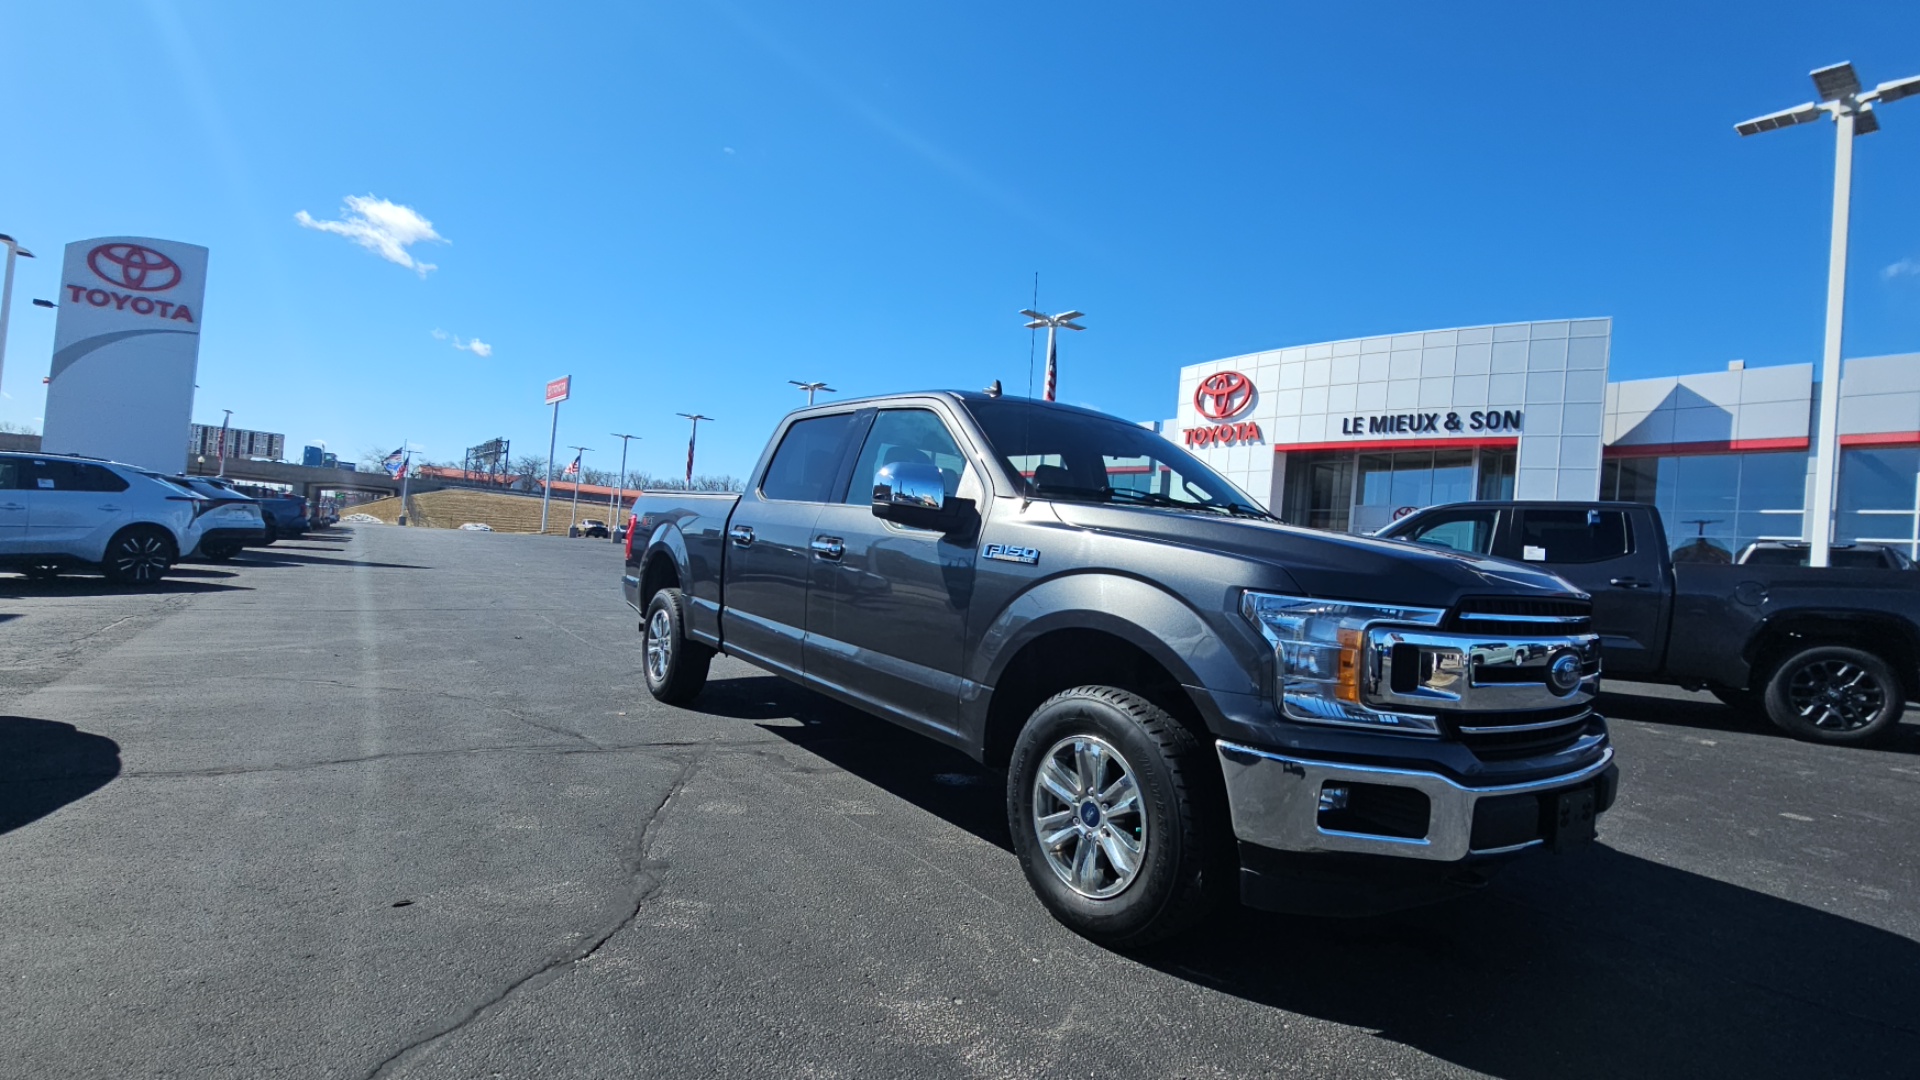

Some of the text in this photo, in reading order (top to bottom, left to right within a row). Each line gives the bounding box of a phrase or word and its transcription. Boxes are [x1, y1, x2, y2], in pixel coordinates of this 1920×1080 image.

[66, 284, 194, 323] TOYOTA
[1183, 421, 1261, 445] TOYOTA
[1342, 410, 1521, 434] LE MIEUX & SON
